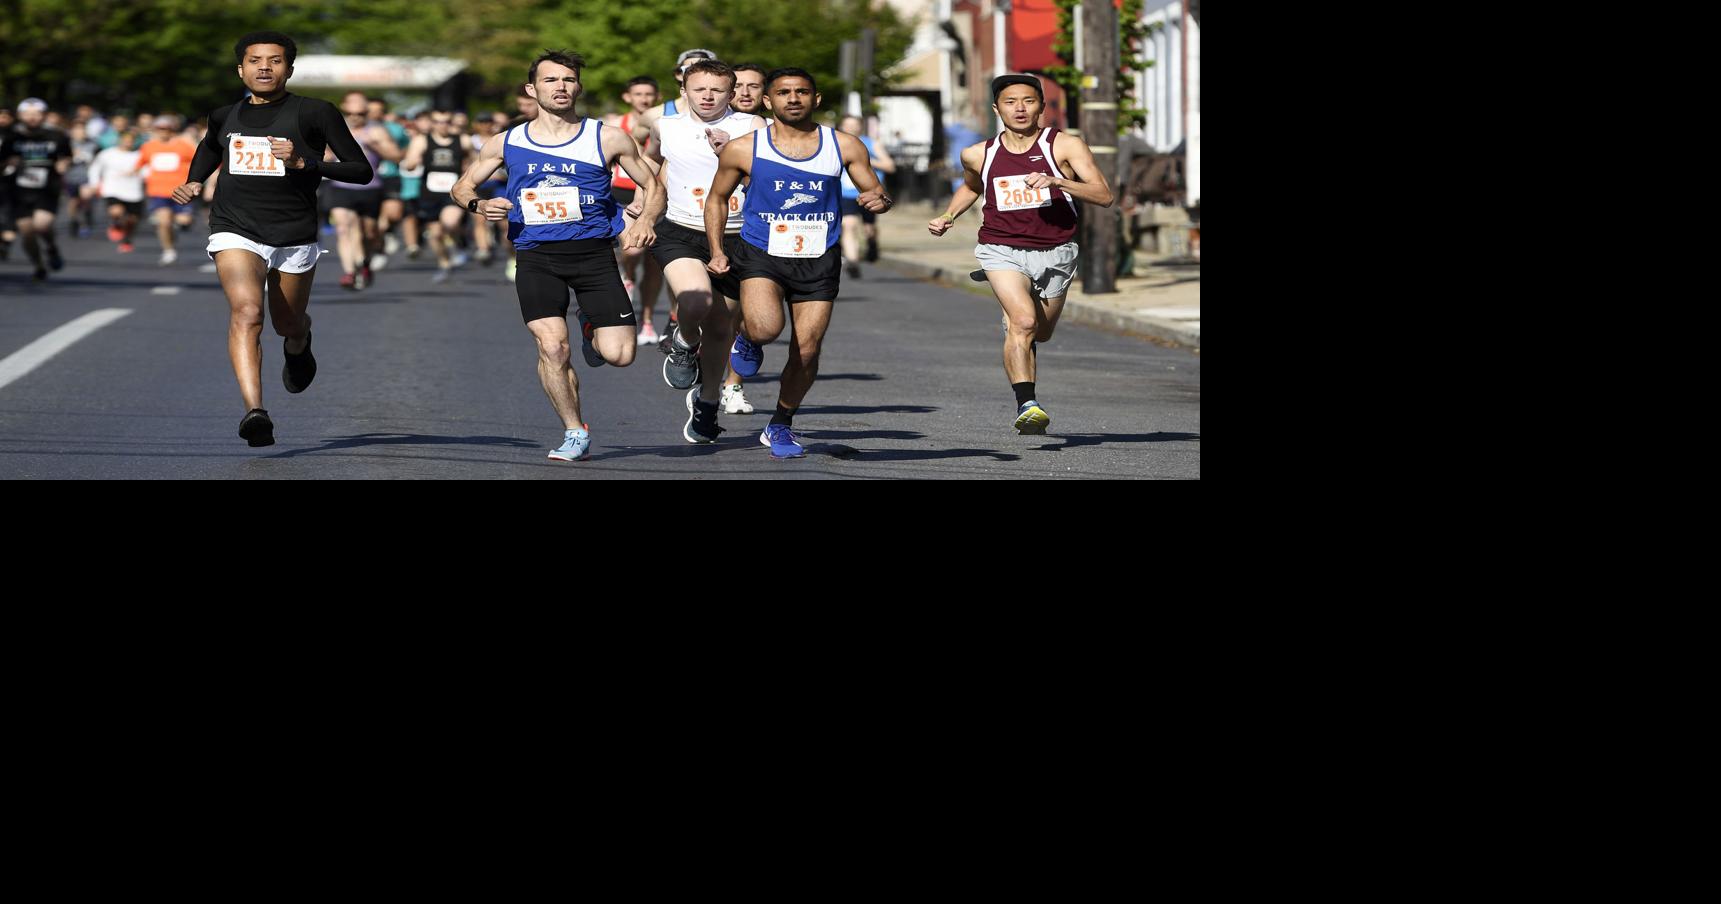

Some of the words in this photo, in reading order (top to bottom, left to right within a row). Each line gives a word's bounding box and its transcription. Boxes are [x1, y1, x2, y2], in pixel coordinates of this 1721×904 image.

[235, 151, 277, 170] 2211
[527, 163, 537, 174] F
[541, 163, 556, 172] &
[561, 163, 577, 174] M
[774, 180, 785, 191] F
[789, 181, 804, 190] &
[808, 180, 824, 191] M
[1003, 187, 1043, 206] 2661
[534, 201, 568, 219] 355
[758, 211, 802, 225] TRACK
[805, 211, 835, 223] CLUB
[793, 235, 804, 253] 3
